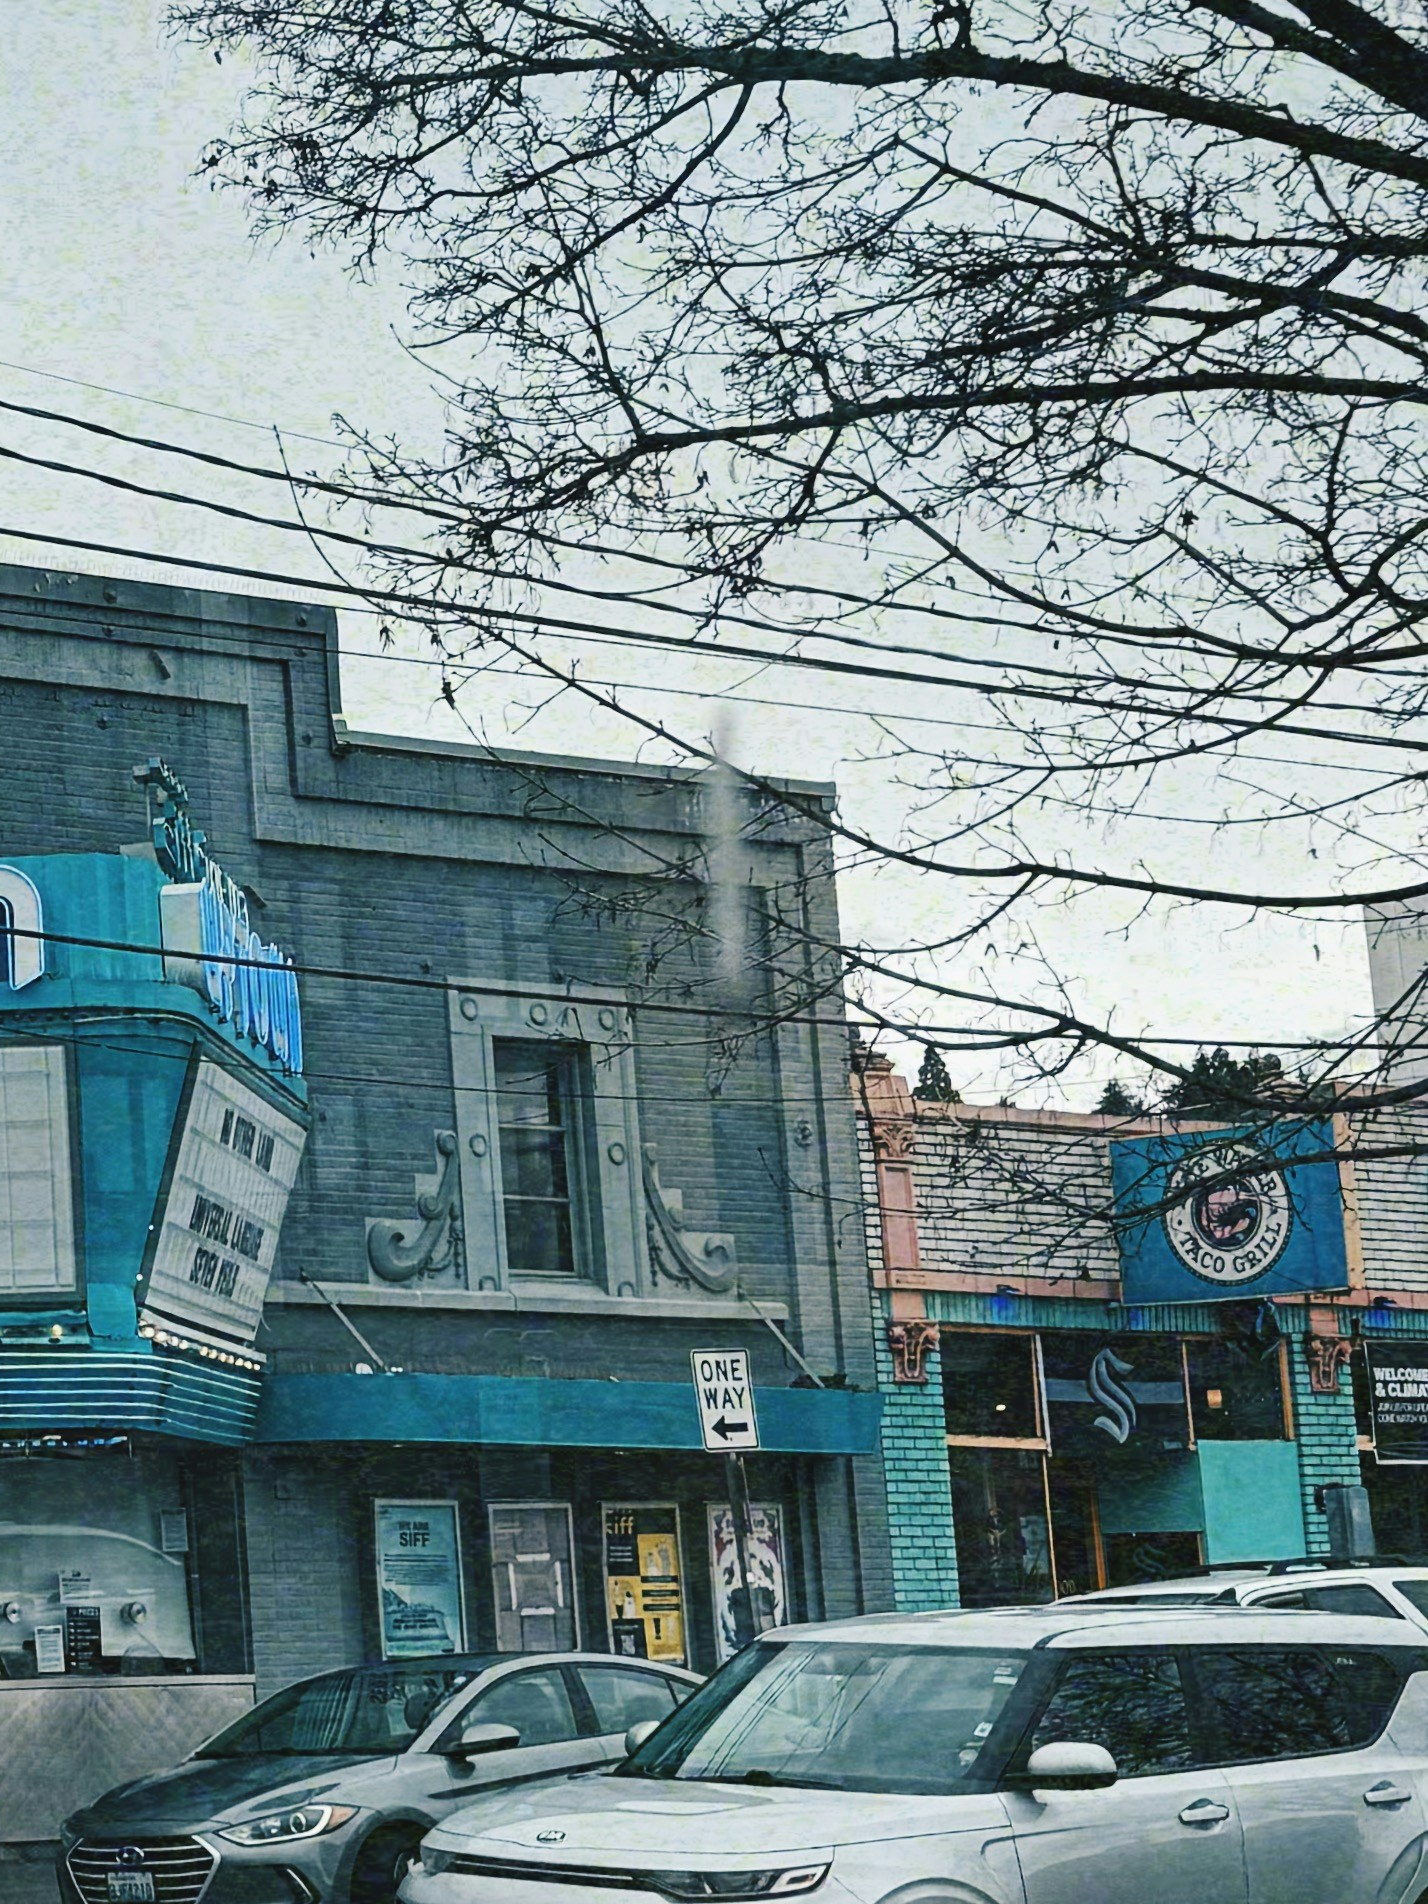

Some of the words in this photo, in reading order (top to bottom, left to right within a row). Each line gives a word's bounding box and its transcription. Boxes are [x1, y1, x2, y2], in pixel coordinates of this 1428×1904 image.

[1178, 1232, 1226, 1273] TACO
[1233, 1222, 1282, 1273] GRILL
[700, 1359, 743, 1382] ONE
[703, 1386, 745, 1410] WAY
[399, 1532, 431, 1548] SIFF
